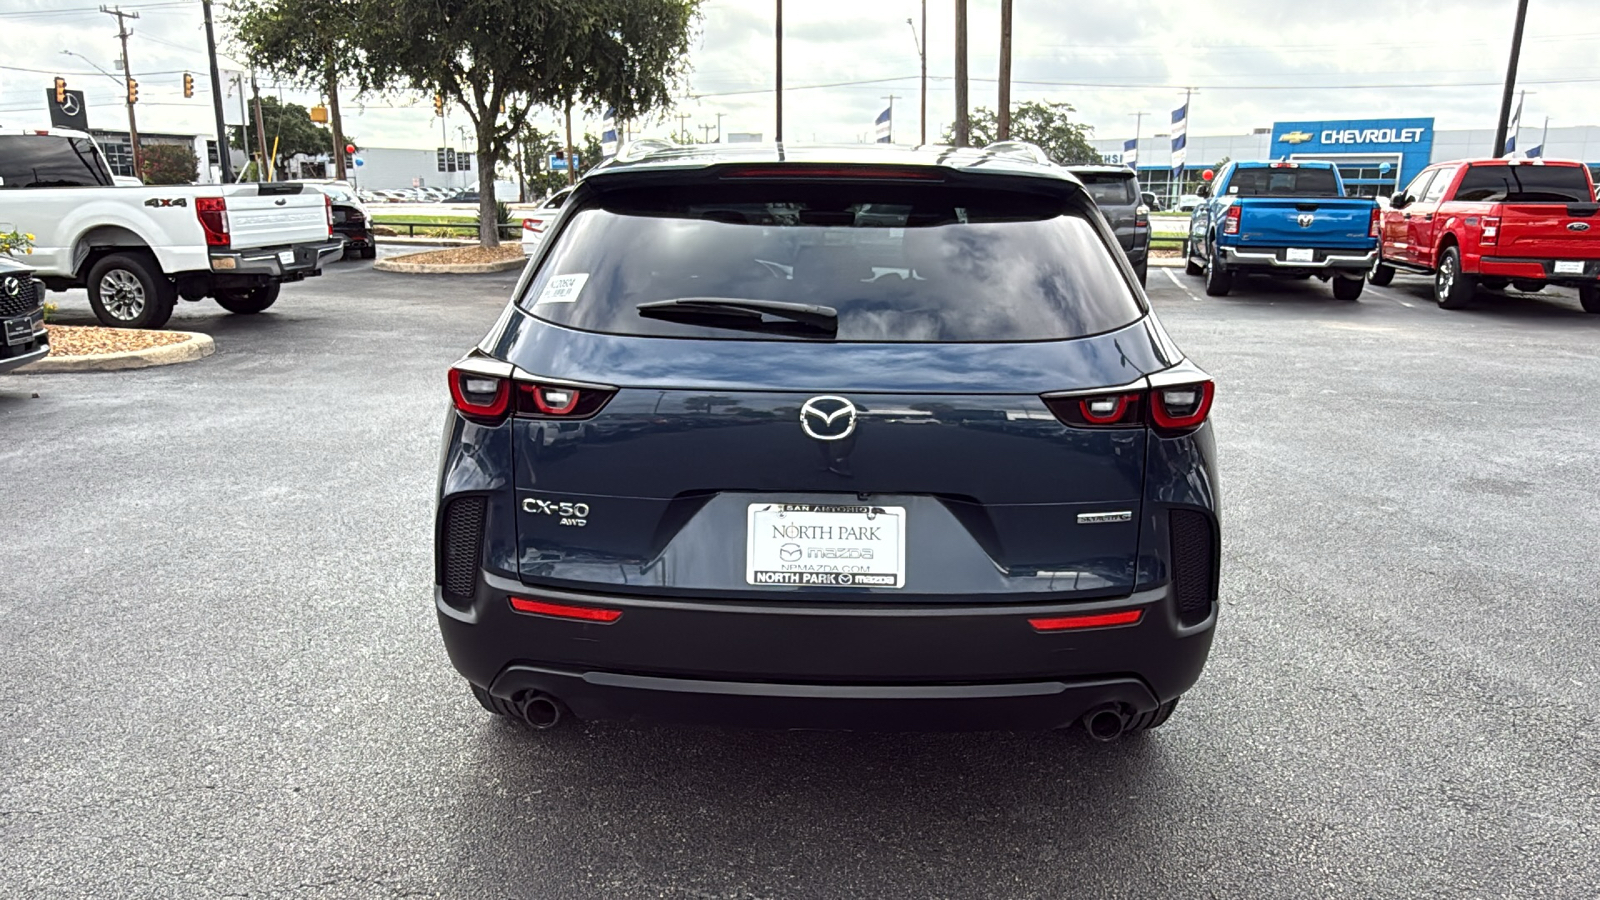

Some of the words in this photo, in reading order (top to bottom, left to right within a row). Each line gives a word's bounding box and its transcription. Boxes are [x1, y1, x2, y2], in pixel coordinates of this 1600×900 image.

[1321, 128, 1425, 144] CHEVROLET
[522, 498, 589, 517] CX-50
[559, 518, 587, 527] AWD
[772, 525, 832, 540] NORTH
[838, 526, 882, 541] PARK
[781, 564, 870, 573] NPMAZDA.COM
[756, 572, 799, 583] NORTH
[803, 573, 836, 584] PARK
[855, 575, 895, 584] mazda
